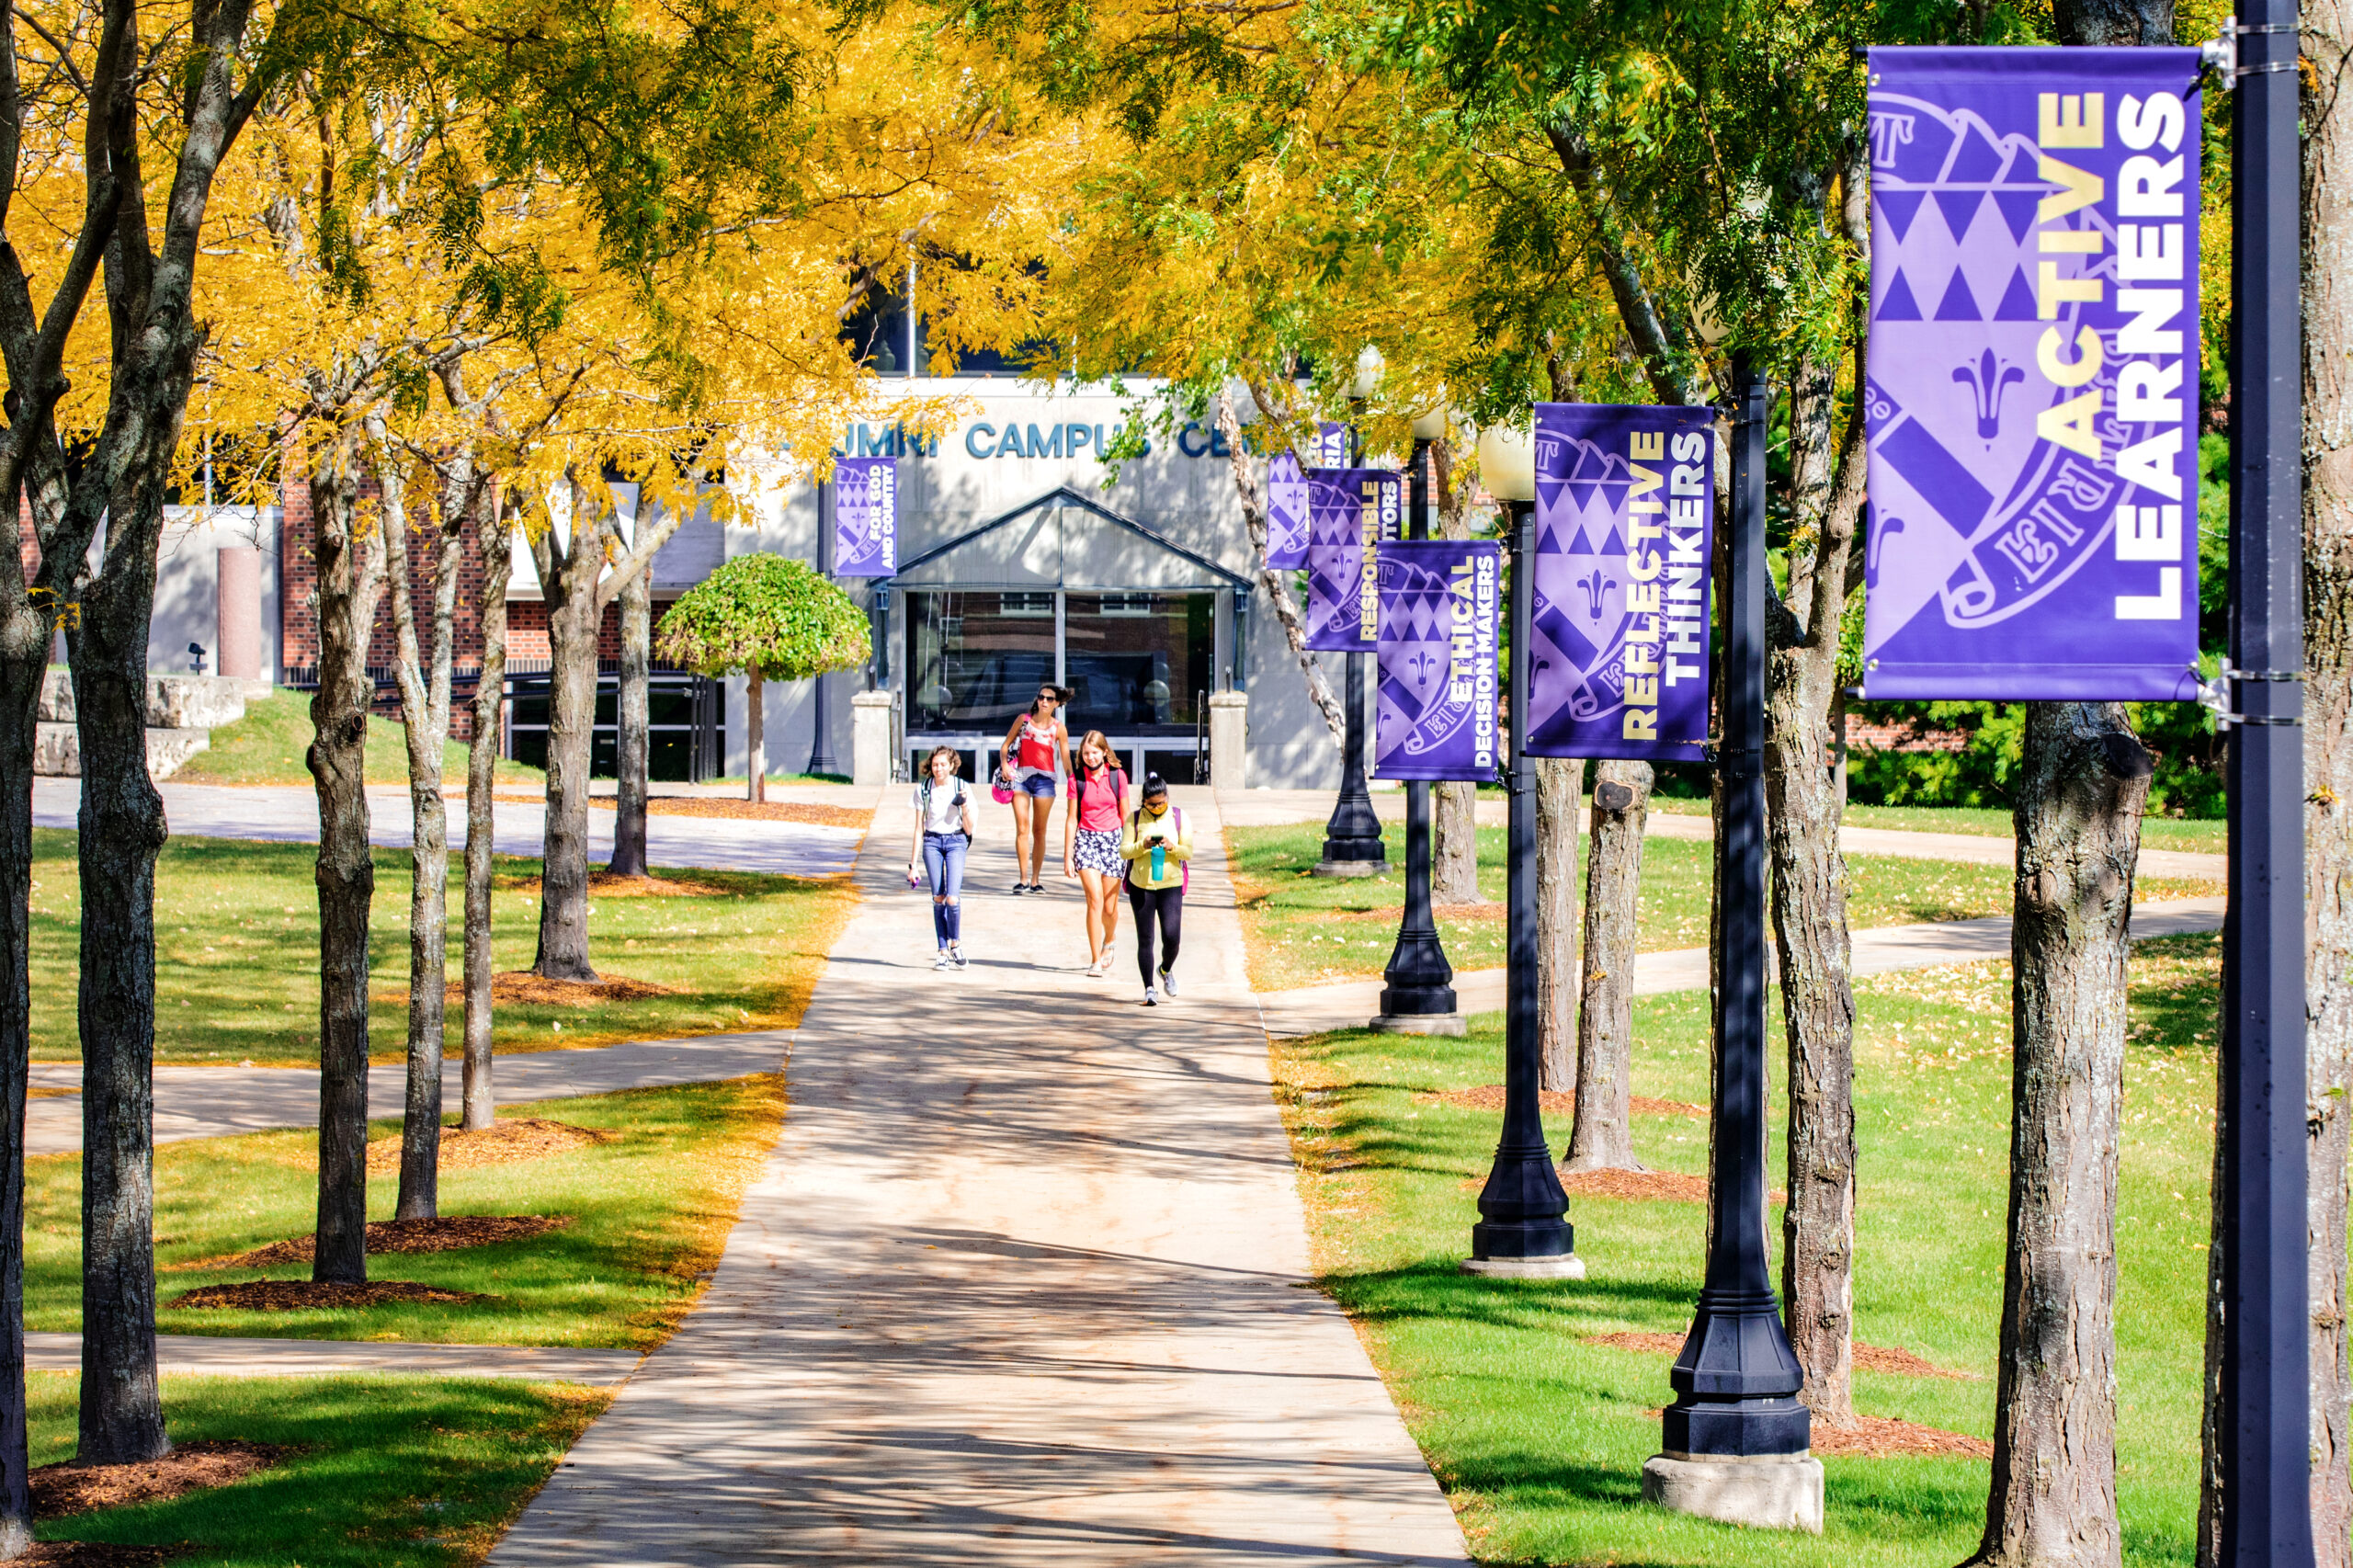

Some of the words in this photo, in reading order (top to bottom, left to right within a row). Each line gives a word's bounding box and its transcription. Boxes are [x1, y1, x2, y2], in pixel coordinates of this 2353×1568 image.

[2037, 91, 2105, 460] ACTIVE
[2115, 91, 2186, 620] LEARNERS
[870, 464, 882, 501] GOD
[870, 506, 882, 540] FOR
[881, 463, 894, 535] COUNTRY
[881, 537, 894, 569] AND
[1360, 481, 1380, 642] RESPONSIBLE
[1476, 554, 1495, 654] MAKERS
[1622, 431, 1665, 741] REFLECTIVE
[1665, 432, 1706, 687] THINKERS
[1450, 555, 1474, 703] ETHICAL
[1474, 657, 1494, 768] DECISION
